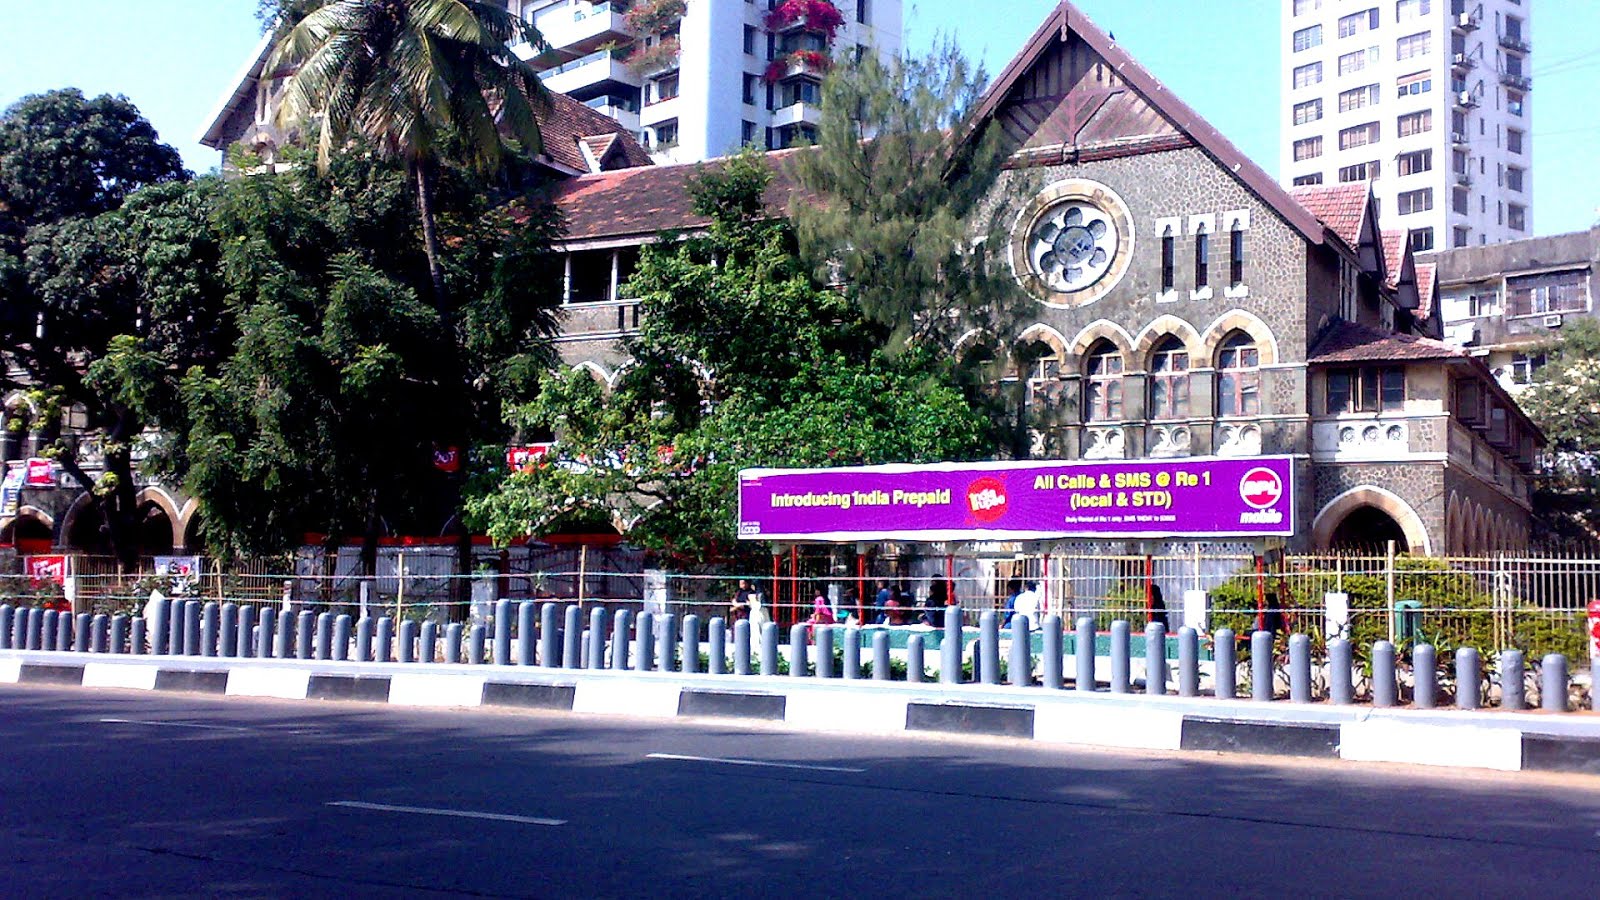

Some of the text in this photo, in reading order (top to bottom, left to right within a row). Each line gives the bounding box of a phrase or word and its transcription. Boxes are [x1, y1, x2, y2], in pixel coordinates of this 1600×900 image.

[1033, 471, 1211, 490] All Calls & SMS @ Re 1
[771, 491, 851, 509] Introducing
[892, 488, 951, 509] Prepaid
[1070, 490, 1172, 511] (local & STD)
[1240, 508, 1283, 524] mobile
